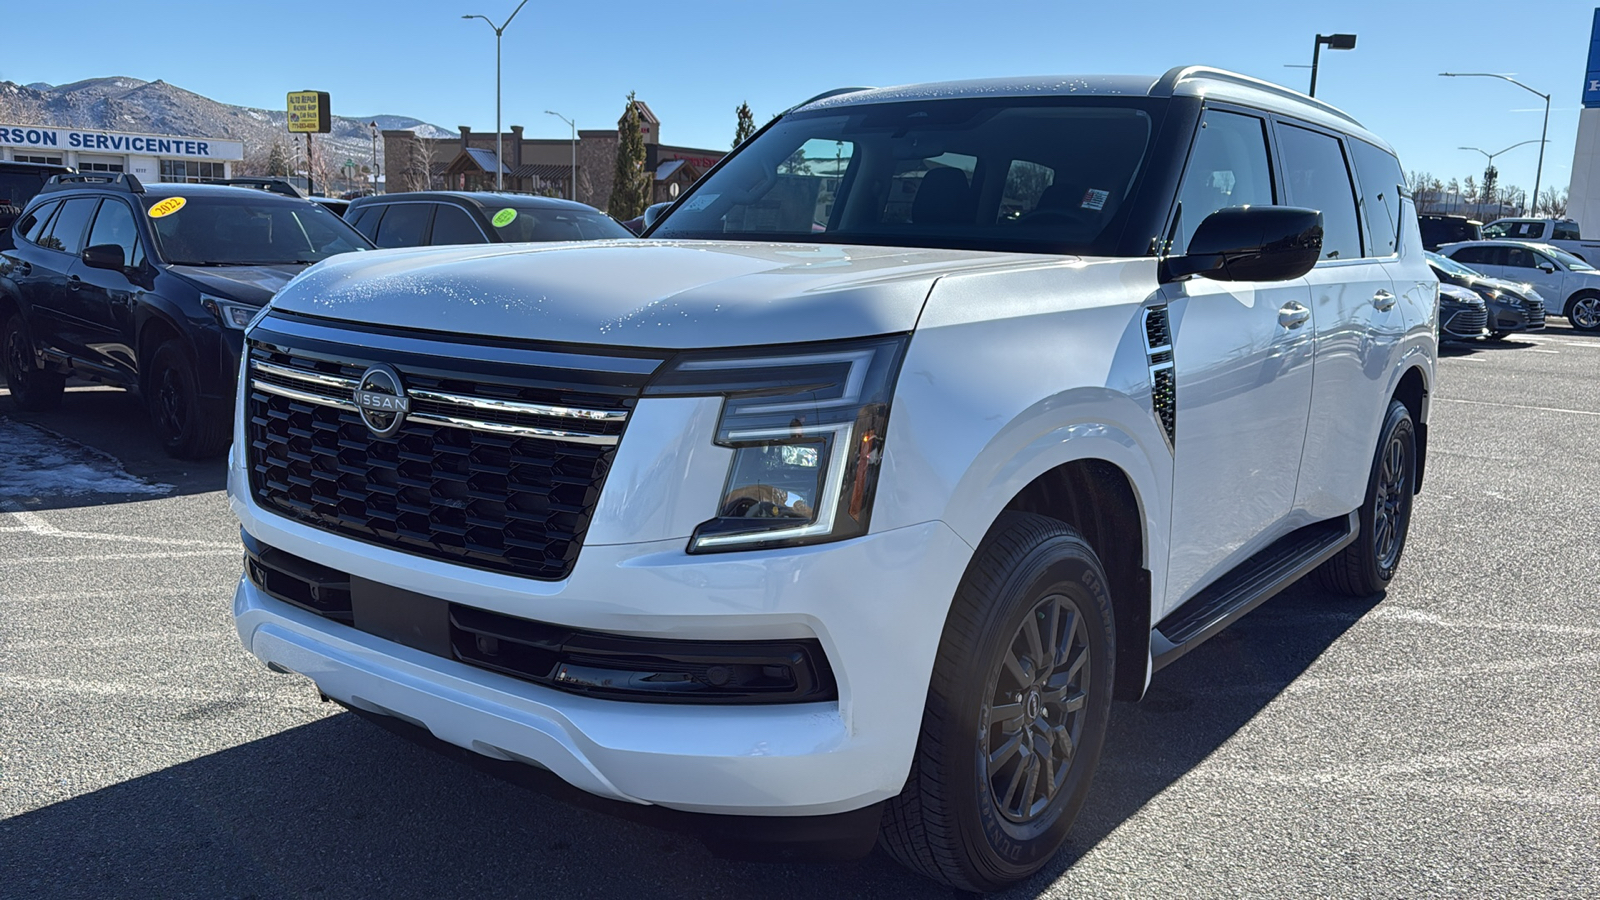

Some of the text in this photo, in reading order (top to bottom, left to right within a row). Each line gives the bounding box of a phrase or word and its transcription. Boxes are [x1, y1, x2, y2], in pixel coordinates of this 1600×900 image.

[68, 132, 210, 156] SERVICENTER
[155, 198, 181, 215] 2022
[353, 391, 407, 410] NISSAN
